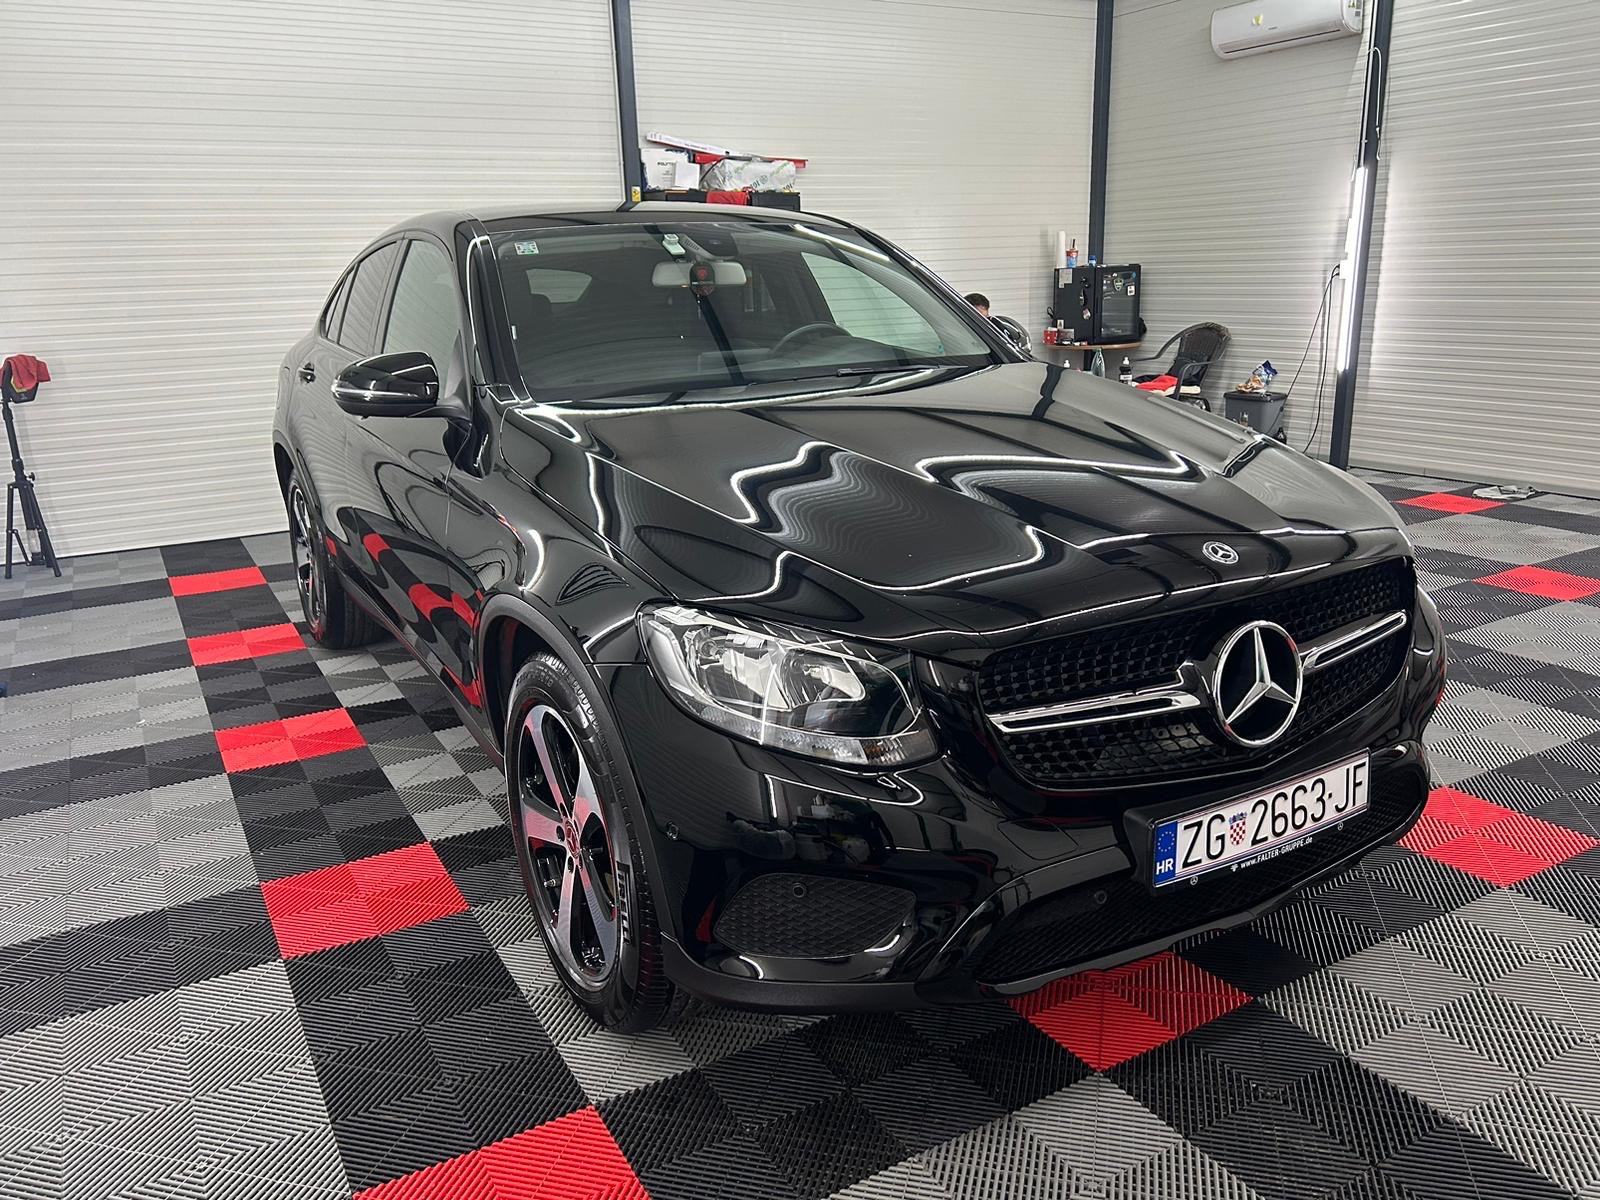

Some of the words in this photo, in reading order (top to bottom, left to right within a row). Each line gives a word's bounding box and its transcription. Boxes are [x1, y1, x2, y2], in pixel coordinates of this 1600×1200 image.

[1156, 858, 1174, 875] HR
[1182, 813, 1226, 869] ZG
[1240, 836, 1313, 869] www.FALTER-GRUPPE.de
